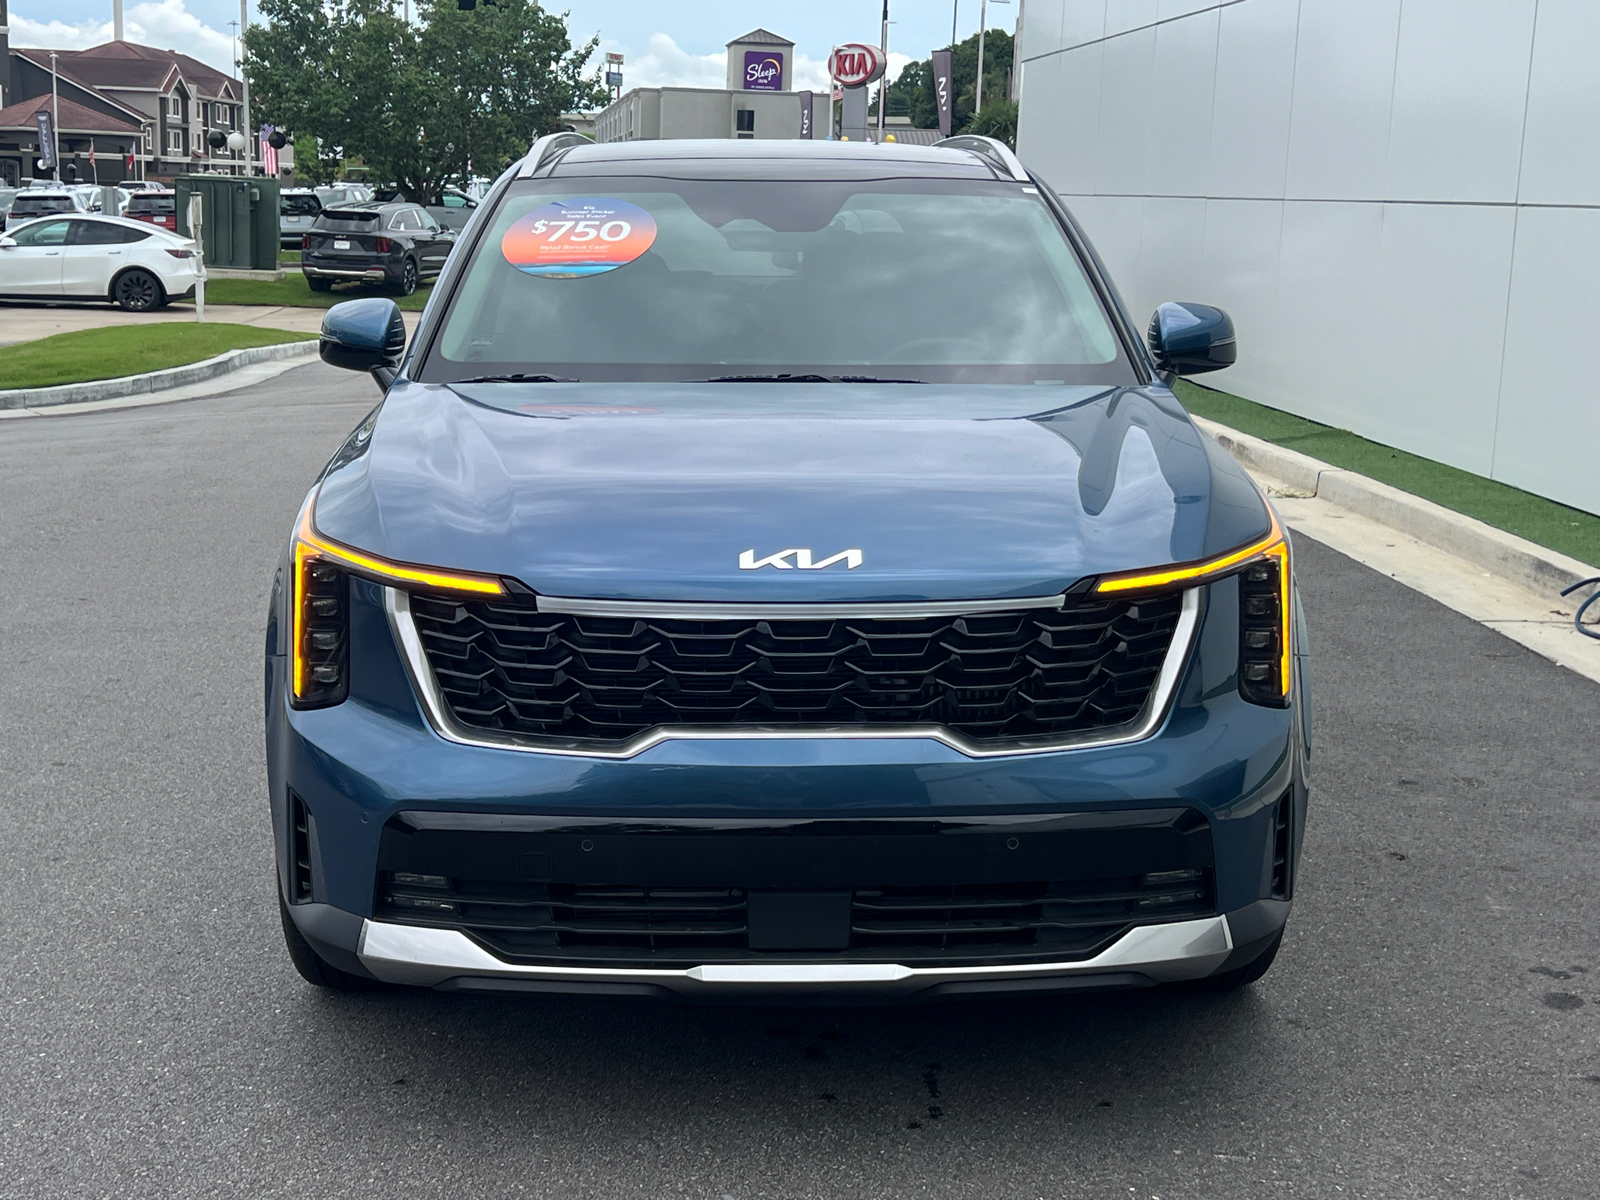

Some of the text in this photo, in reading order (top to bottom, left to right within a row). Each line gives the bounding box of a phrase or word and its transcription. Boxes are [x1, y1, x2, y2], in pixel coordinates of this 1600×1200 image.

[747, 63, 777, 81] Sleep
[836, 53, 868, 76] KIA
[41, 122, 51, 164] CADILLAC
[531, 219, 631, 242] $750
[739, 548, 863, 570] KIA
